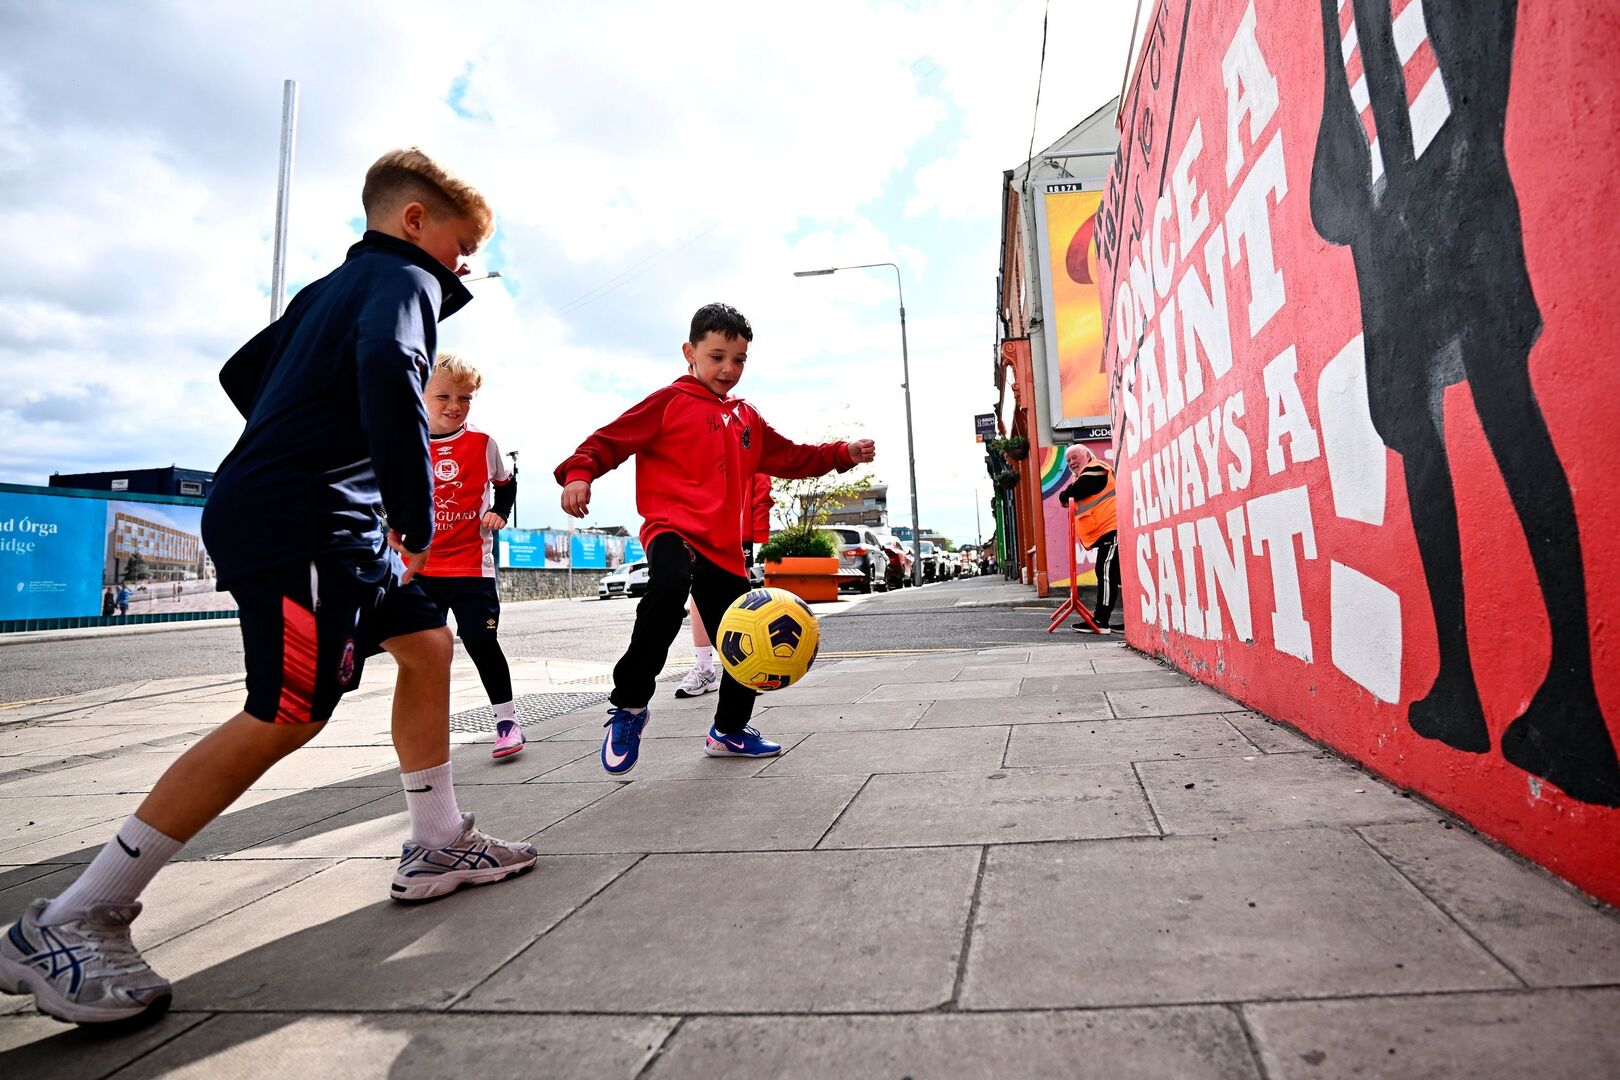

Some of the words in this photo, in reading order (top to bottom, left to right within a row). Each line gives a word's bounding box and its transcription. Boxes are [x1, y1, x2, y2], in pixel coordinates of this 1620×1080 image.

[1115, 116, 1211, 361] ONCE
[1221, 0, 1280, 189] A
[1122, 128, 1289, 459] SAINT
[19, 515, 58, 537] Órga
[434, 510, 477, 522] GUARD
[1131, 390, 1252, 528] ALWAYS
[1262, 344, 1320, 476] A
